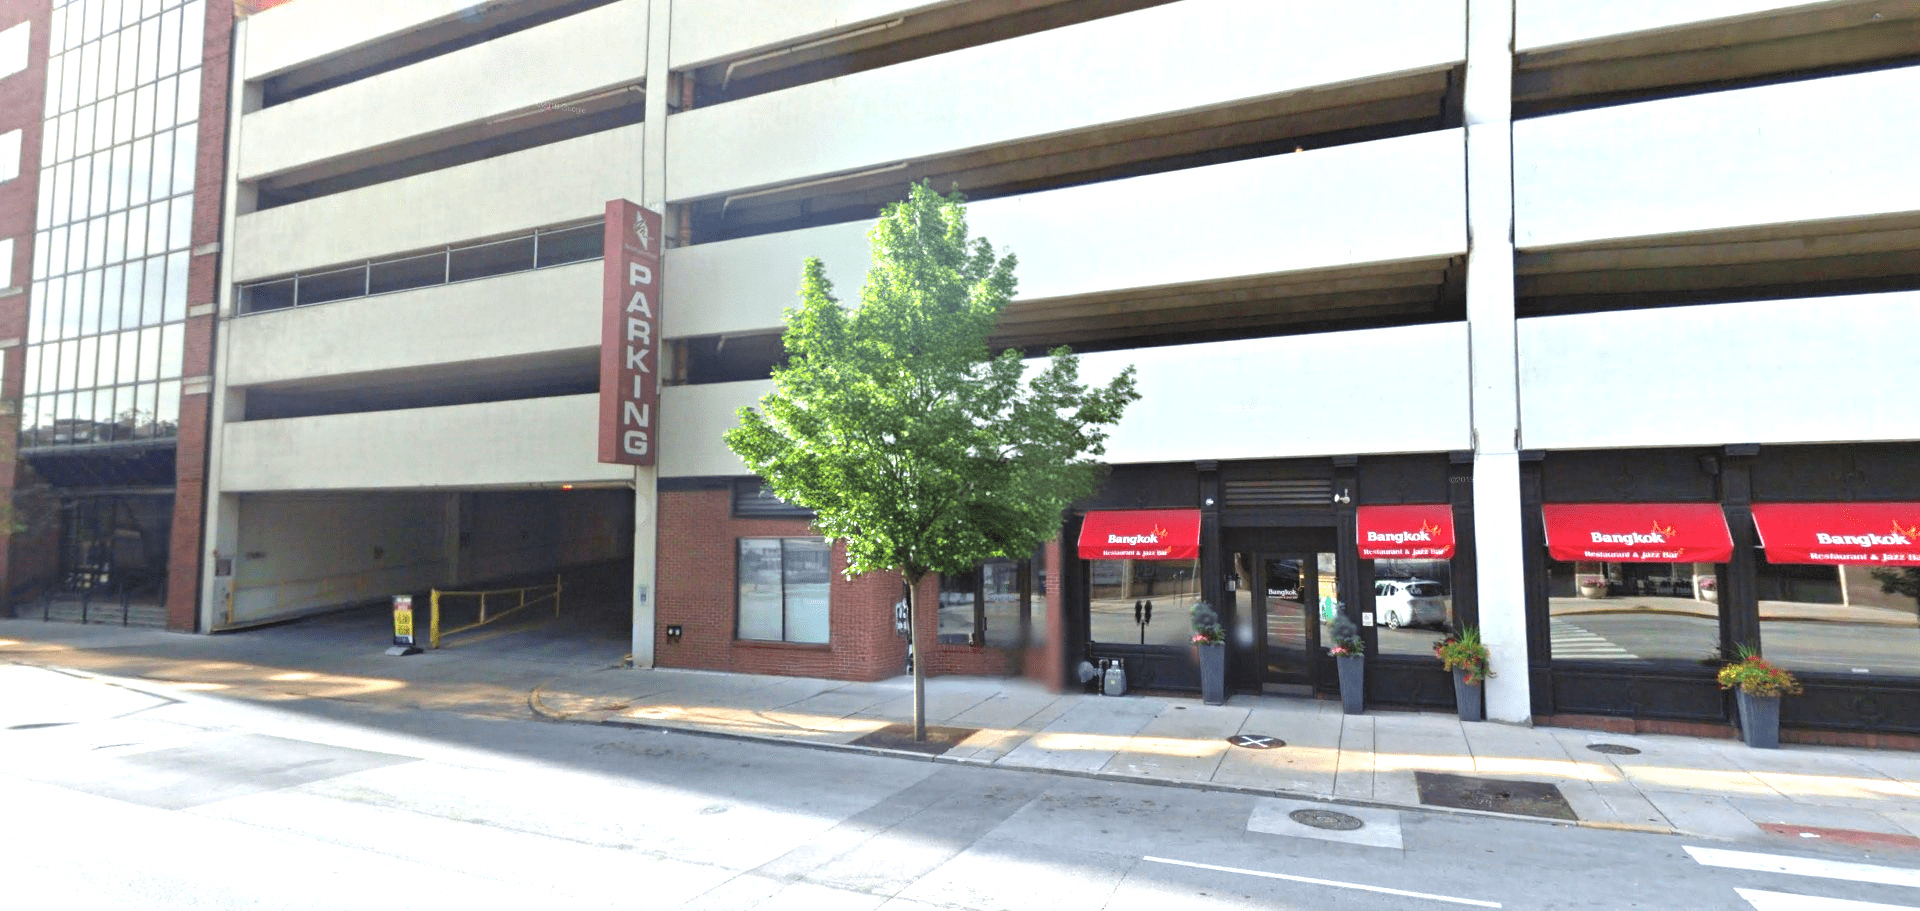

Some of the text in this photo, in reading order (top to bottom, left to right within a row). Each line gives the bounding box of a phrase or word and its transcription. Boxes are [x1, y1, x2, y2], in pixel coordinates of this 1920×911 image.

[623, 262, 652, 456] PARKING
[1108, 534, 1159, 546] Bangkok
[1367, 531, 1431, 544] Bangkok
[1590, 532, 1666, 546] Bangkok
[1816, 533, 1912, 547] Bangkok
[1412, 548, 1429, 556] Jazz
[1640, 551, 1661, 559] Jazz
[1809, 552, 1867, 560] Restaurant
[1882, 553, 1906, 562] Jazz
[1268, 588, 1297, 597] Bangkok
